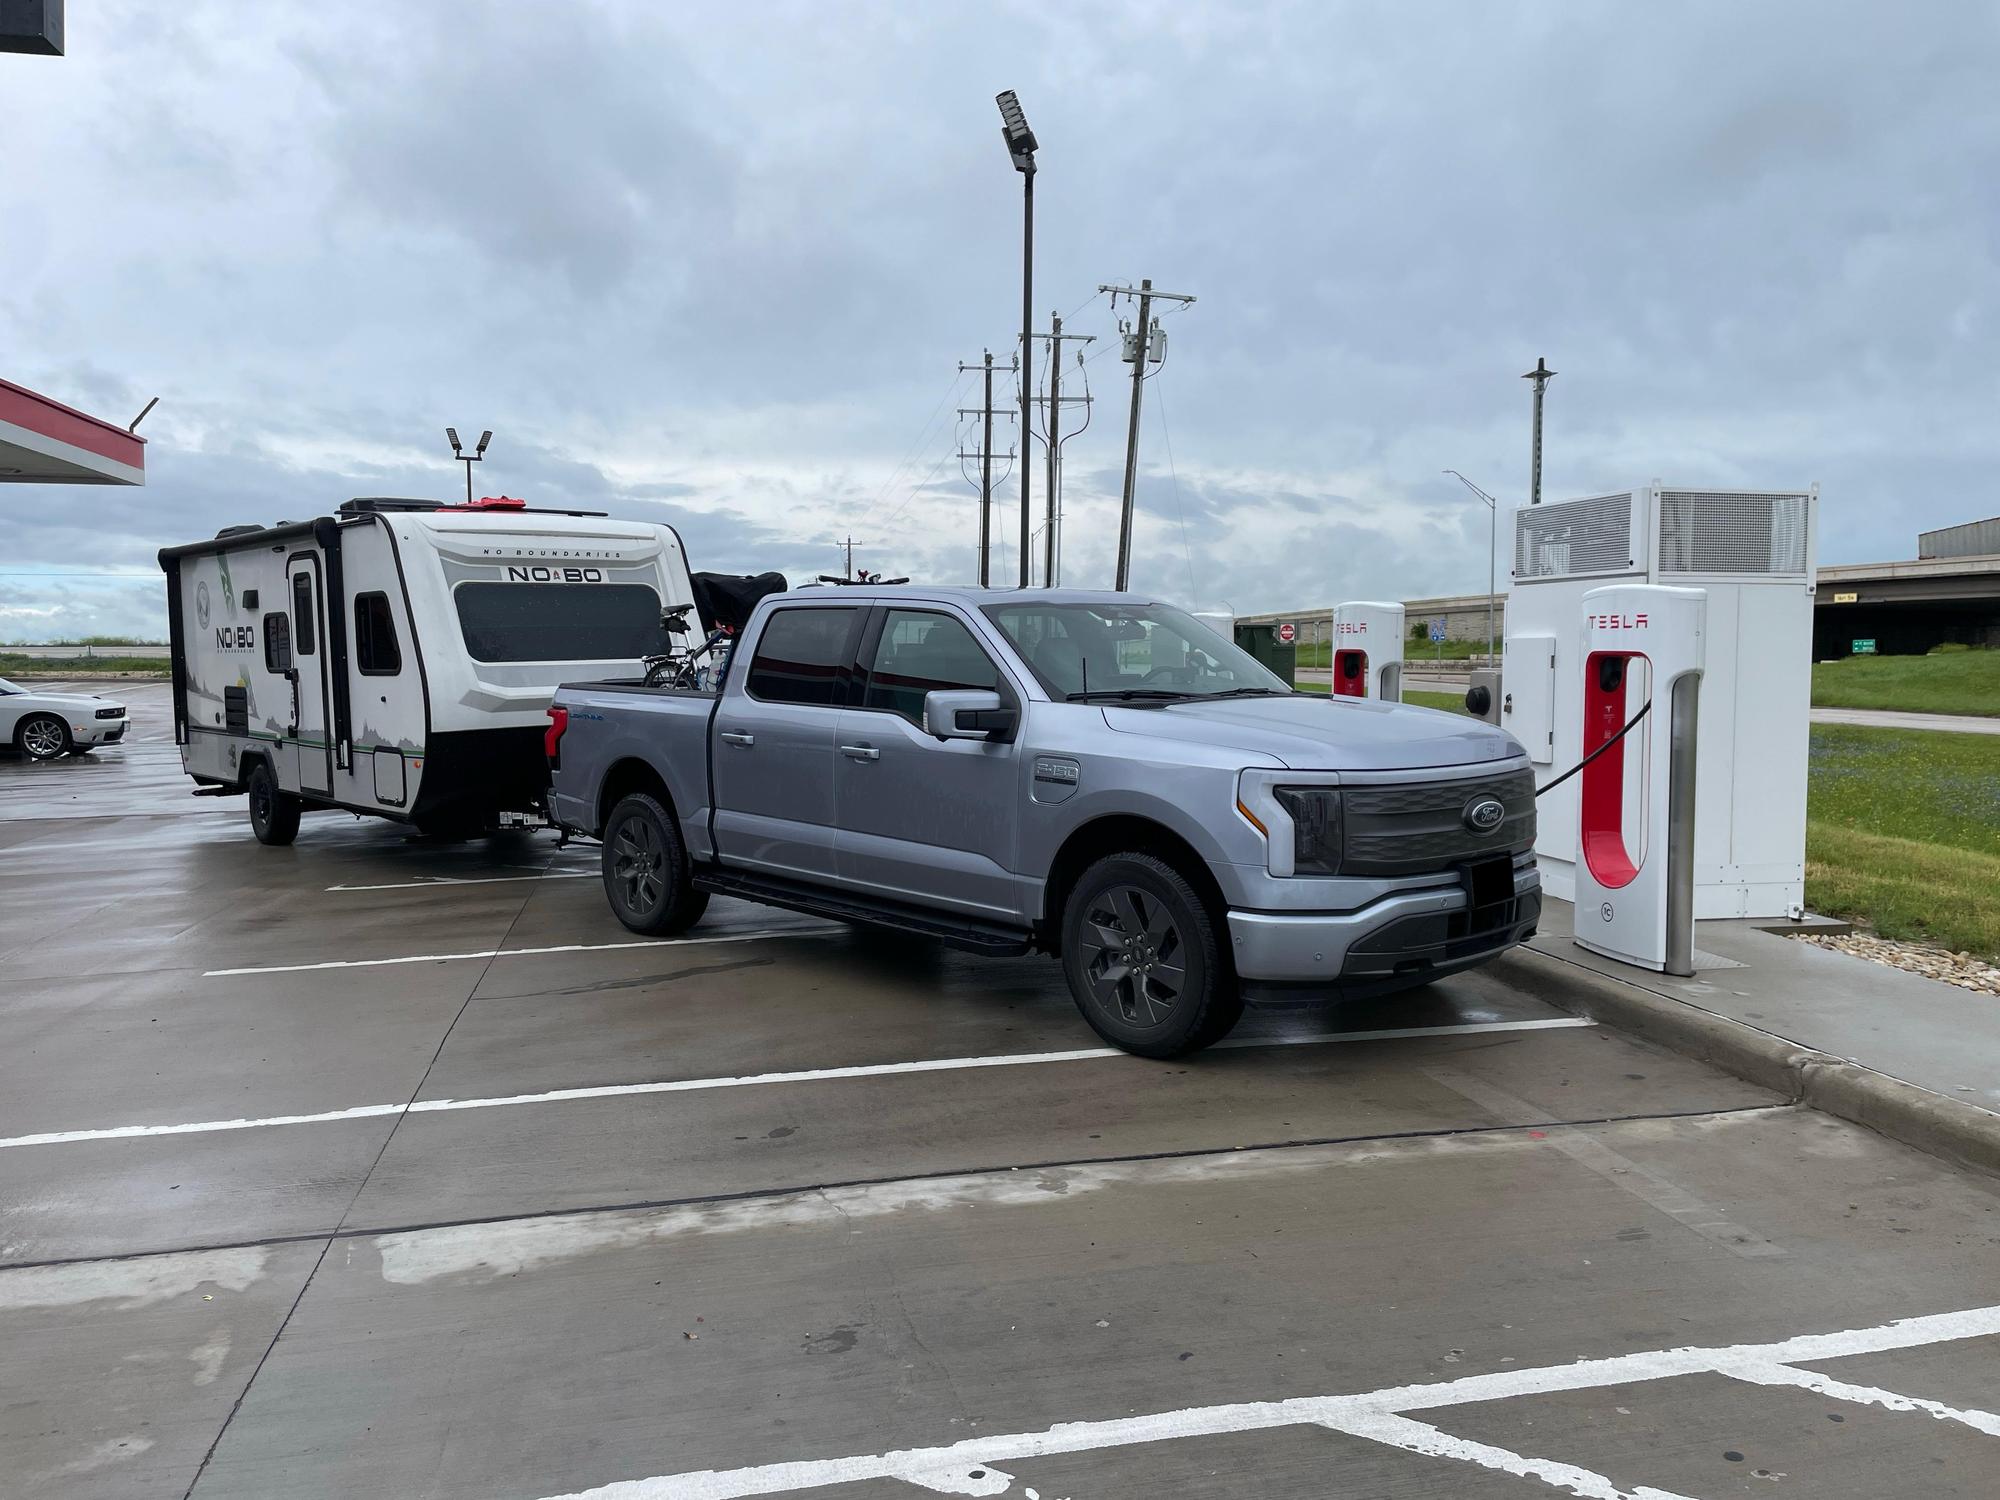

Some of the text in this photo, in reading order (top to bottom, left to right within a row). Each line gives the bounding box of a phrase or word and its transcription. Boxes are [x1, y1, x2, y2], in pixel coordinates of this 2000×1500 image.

[516, 550, 621, 558] BOUNDARIES
[1589, 614, 1648, 629] TESLA
[1336, 623, 1367, 633] TESLA
[1482, 807, 1499, 821] Ford
